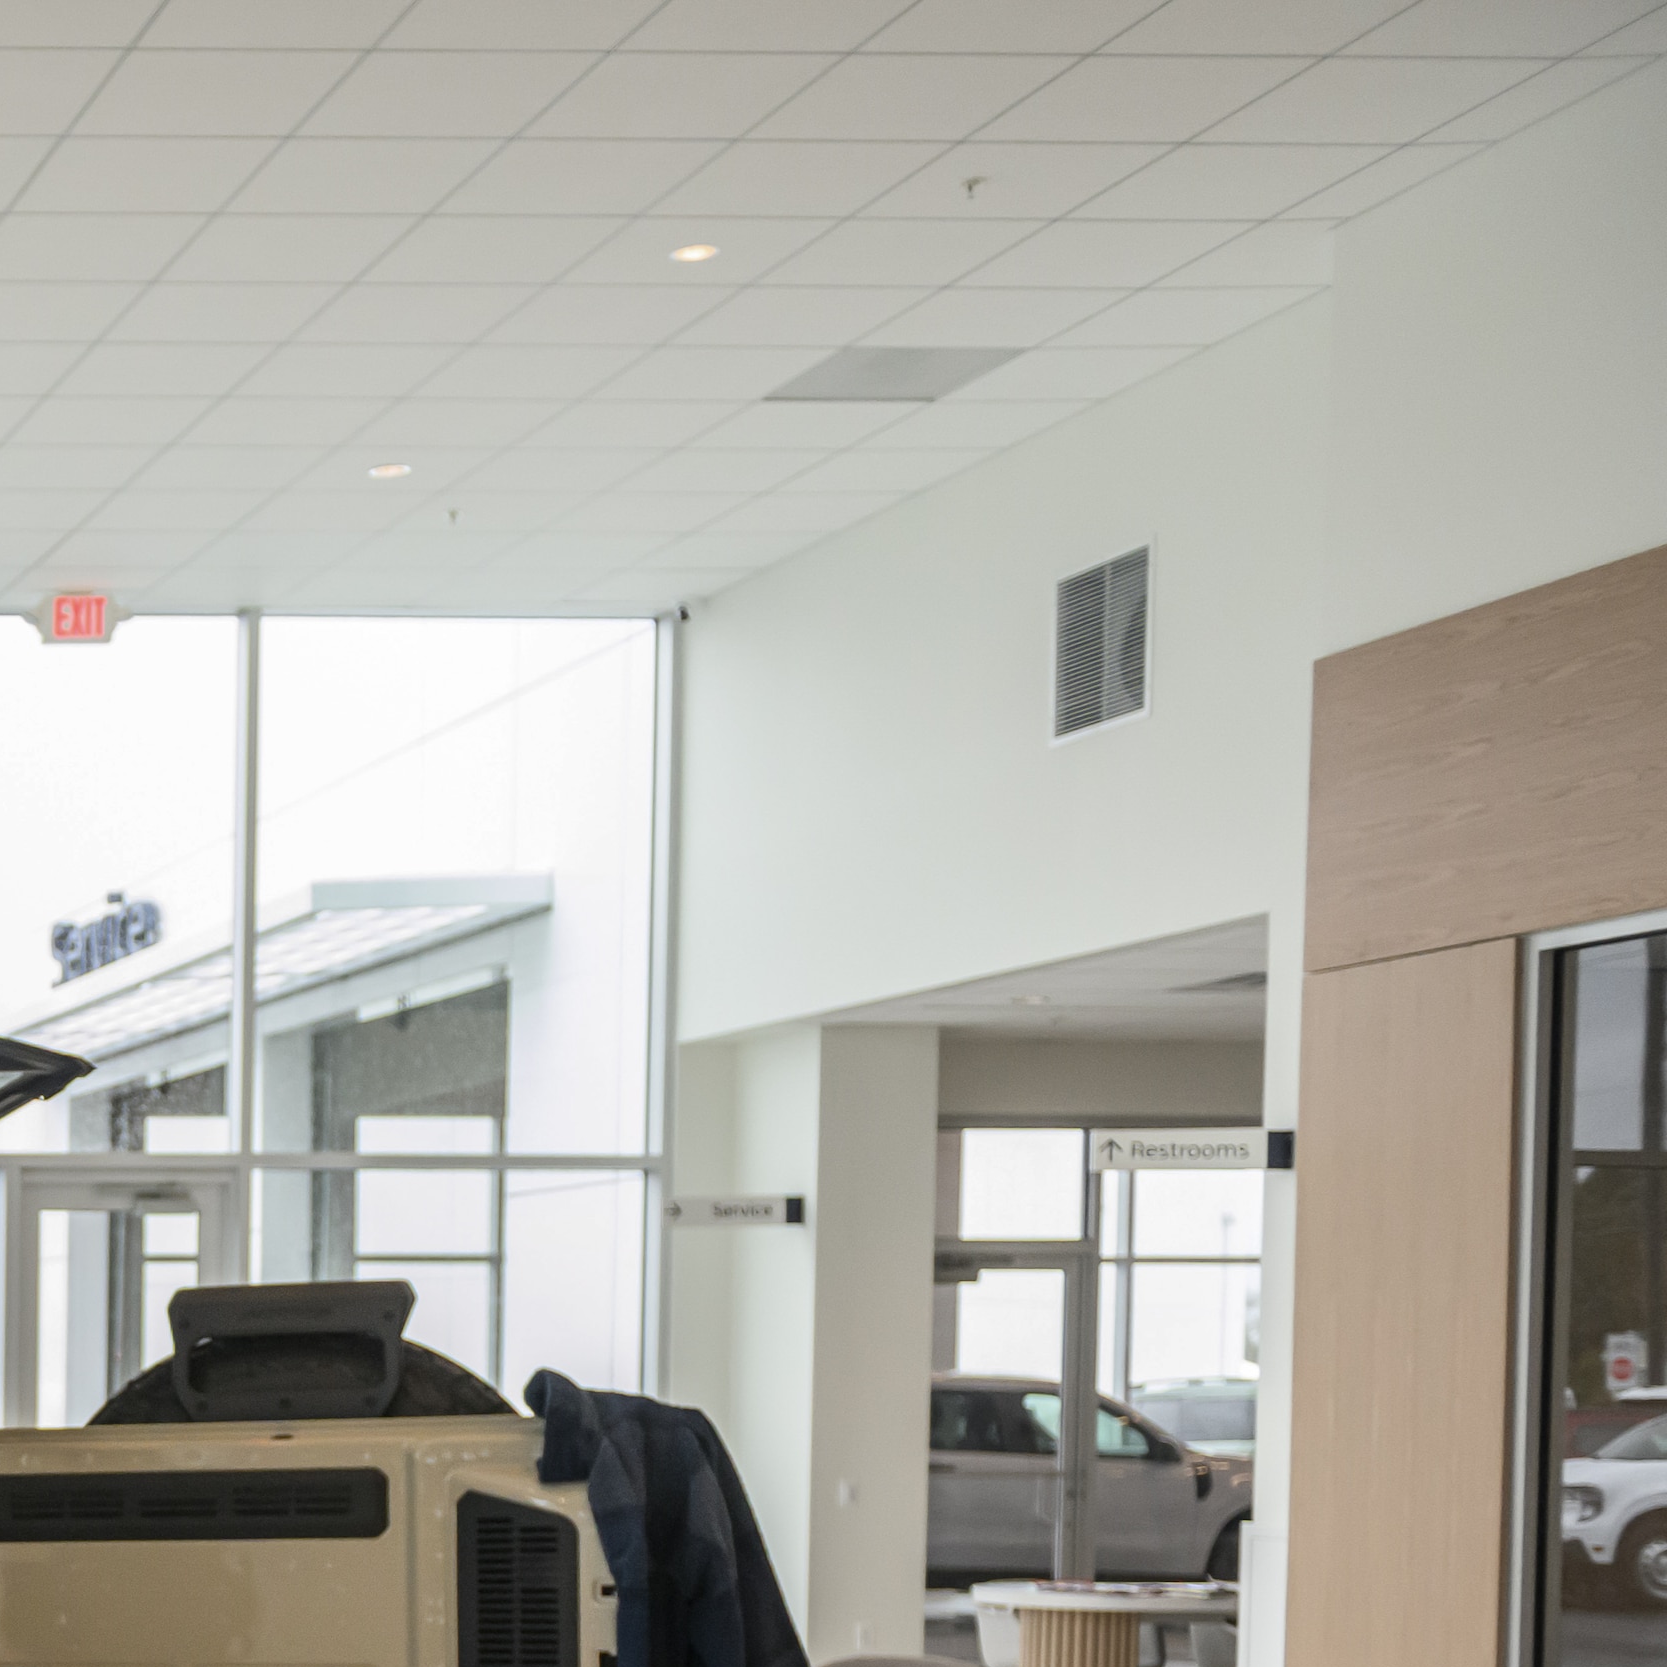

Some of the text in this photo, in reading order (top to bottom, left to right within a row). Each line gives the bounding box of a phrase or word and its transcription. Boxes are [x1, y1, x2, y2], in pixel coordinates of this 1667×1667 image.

[53, 596, 107, 637] EXIT
[1130, 1140, 1250, 1161] Restrooms
[713, 1200, 773, 1218] Service
